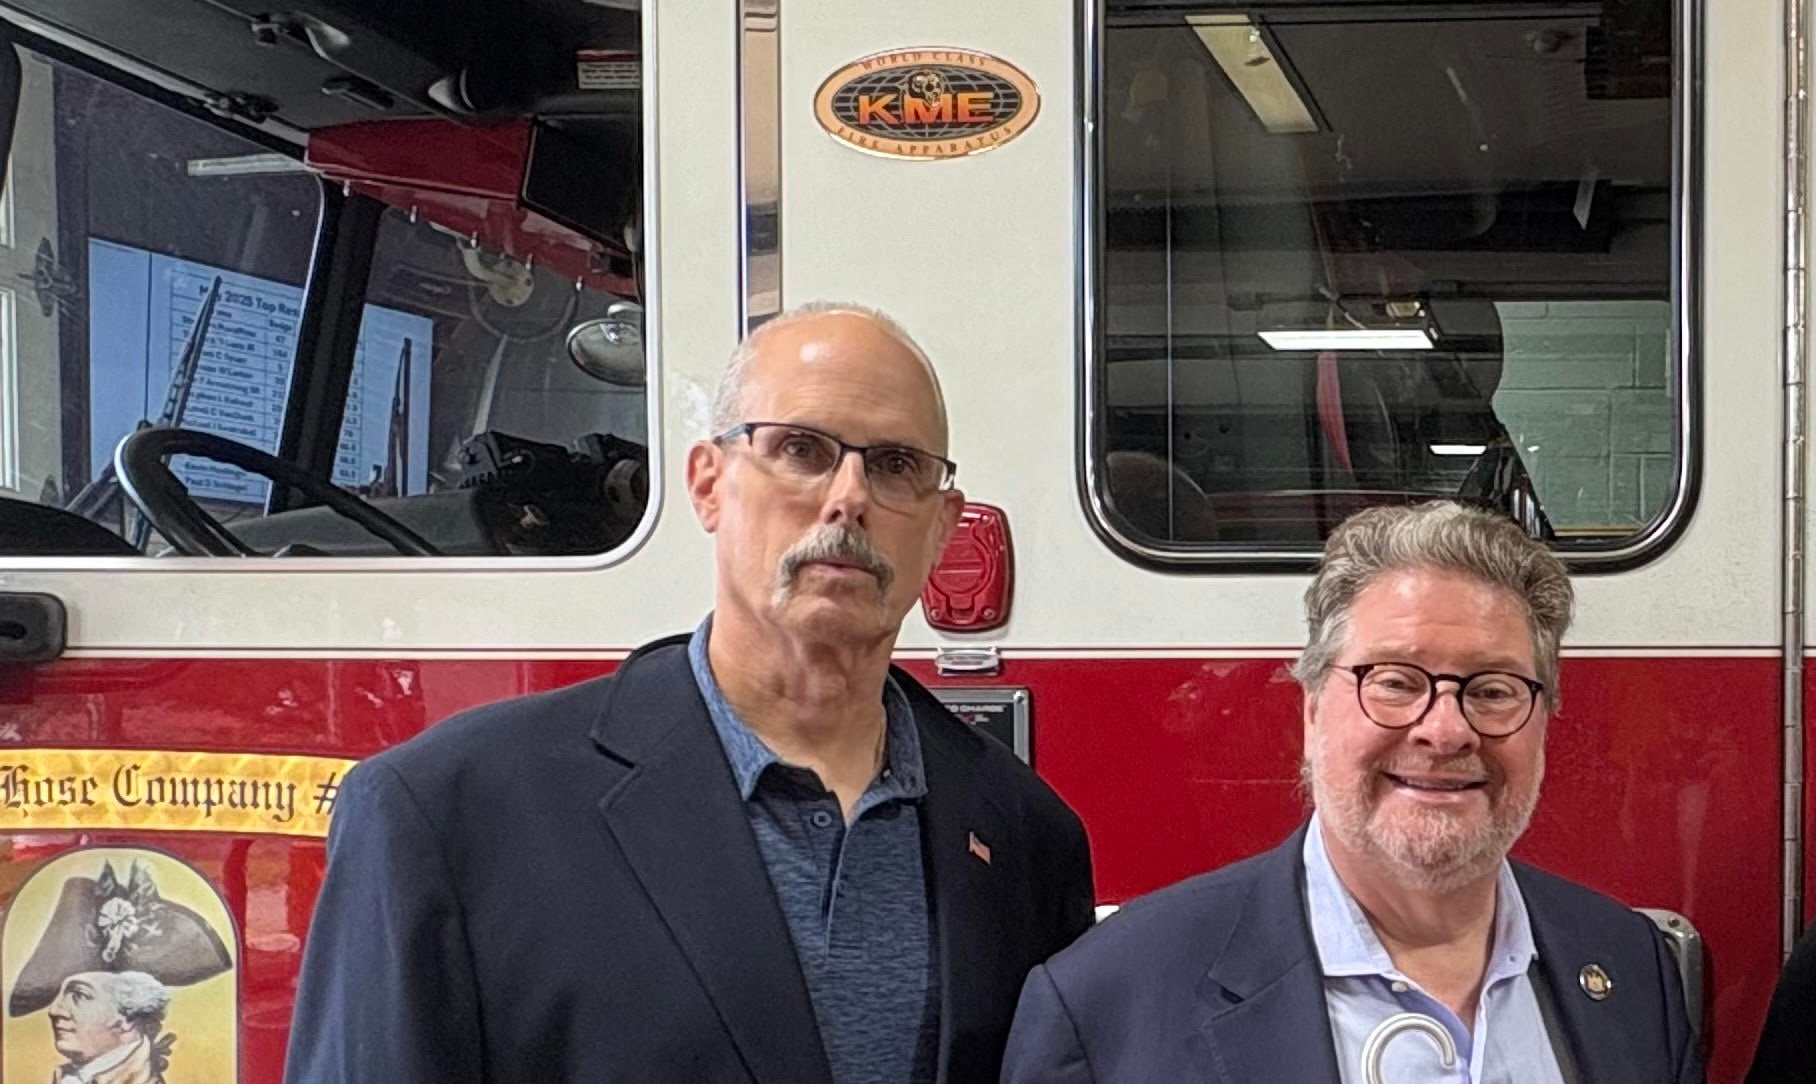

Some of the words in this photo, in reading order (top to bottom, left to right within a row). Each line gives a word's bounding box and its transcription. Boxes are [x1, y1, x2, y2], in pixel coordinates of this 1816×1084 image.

[861, 52, 923, 71] WORLD
[932, 52, 988, 68] CLASS
[858, 91, 995, 125] KME
[836, 125, 880, 150] FIRE
[896, 125, 1013, 155] APPARATUS
[0, 764, 98, 819] Hose
[112, 764, 297, 823] Company
